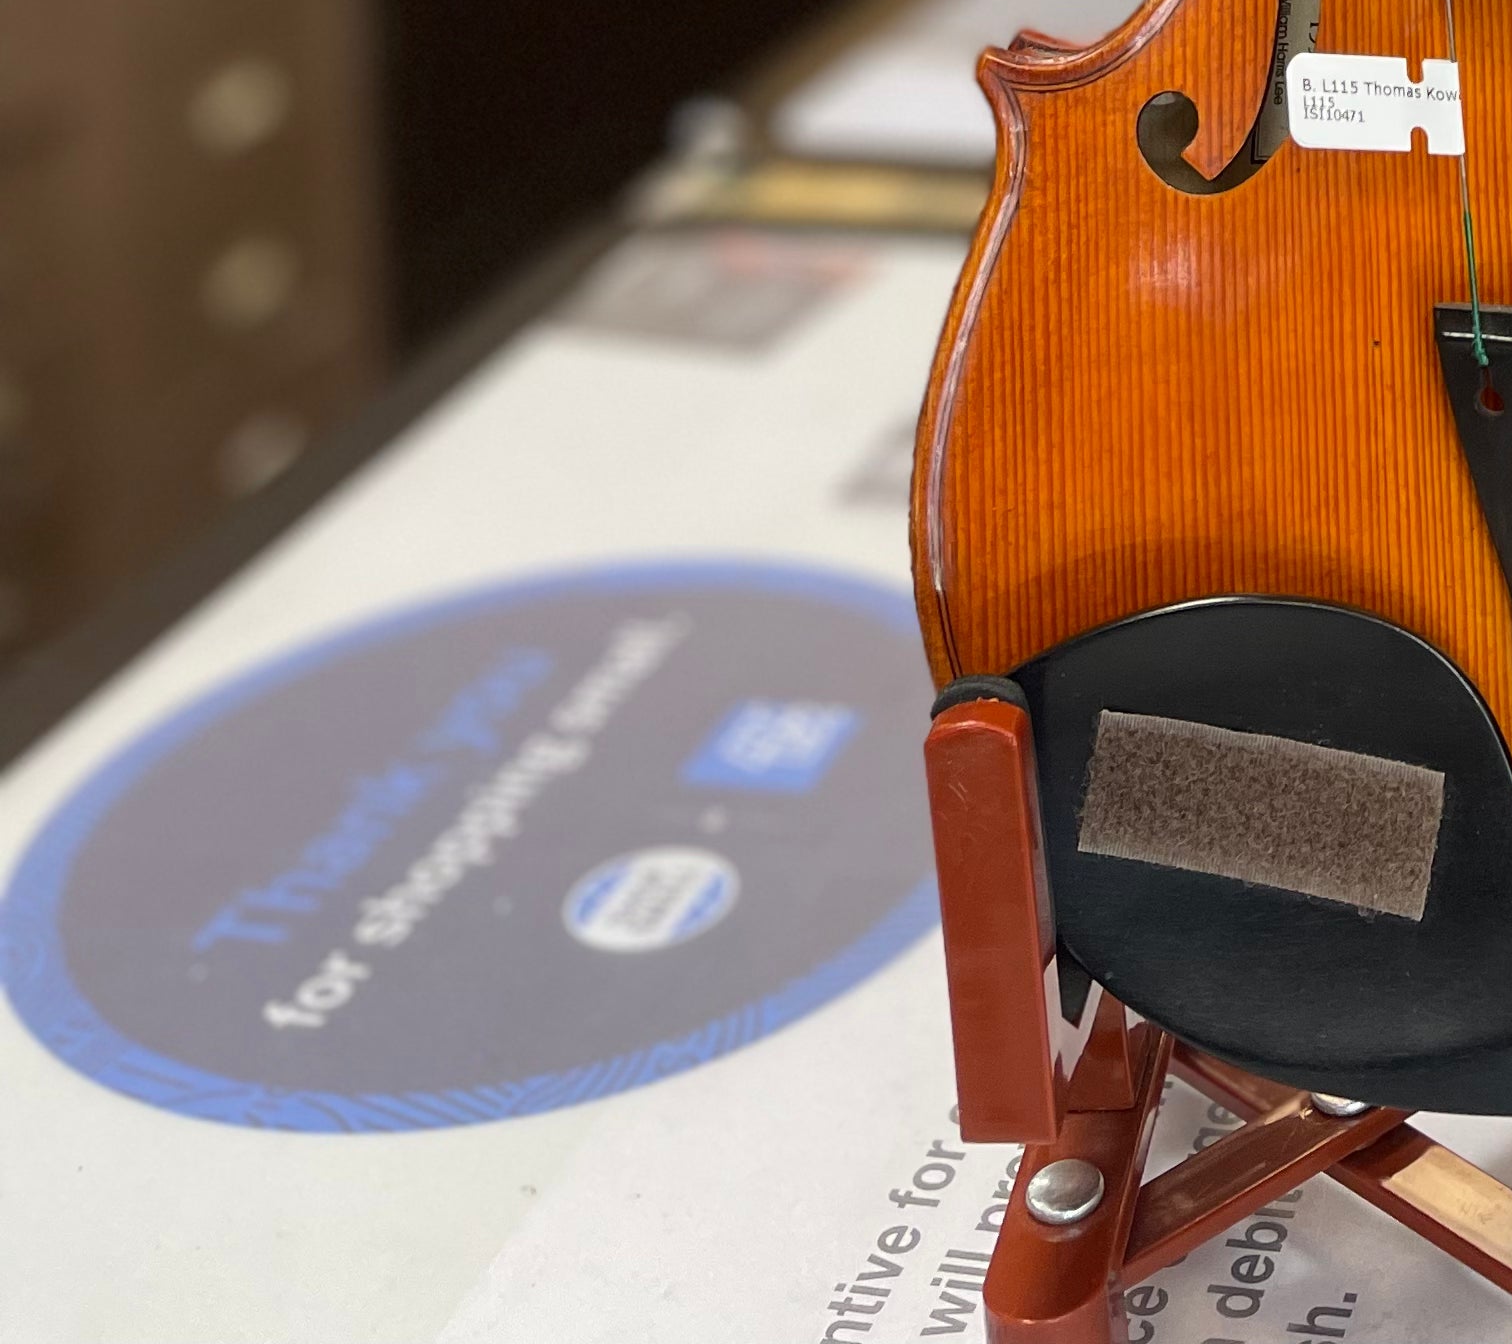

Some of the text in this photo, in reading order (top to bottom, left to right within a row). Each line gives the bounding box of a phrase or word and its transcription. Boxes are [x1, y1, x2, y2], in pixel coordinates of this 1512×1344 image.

[1273, 81, 1285, 105] Lee
[1302, 78, 1317, 92] B.
[1322, 79, 1359, 94] L115
[1363, 82, 1422, 98] Thomas
[1303, 95, 1336, 109] L115
[264, 951, 371, 1032] for
[355, 727, 592, 948] shopping
[888, 1140, 966, 1208] for
[919, 1249, 993, 1336] will
